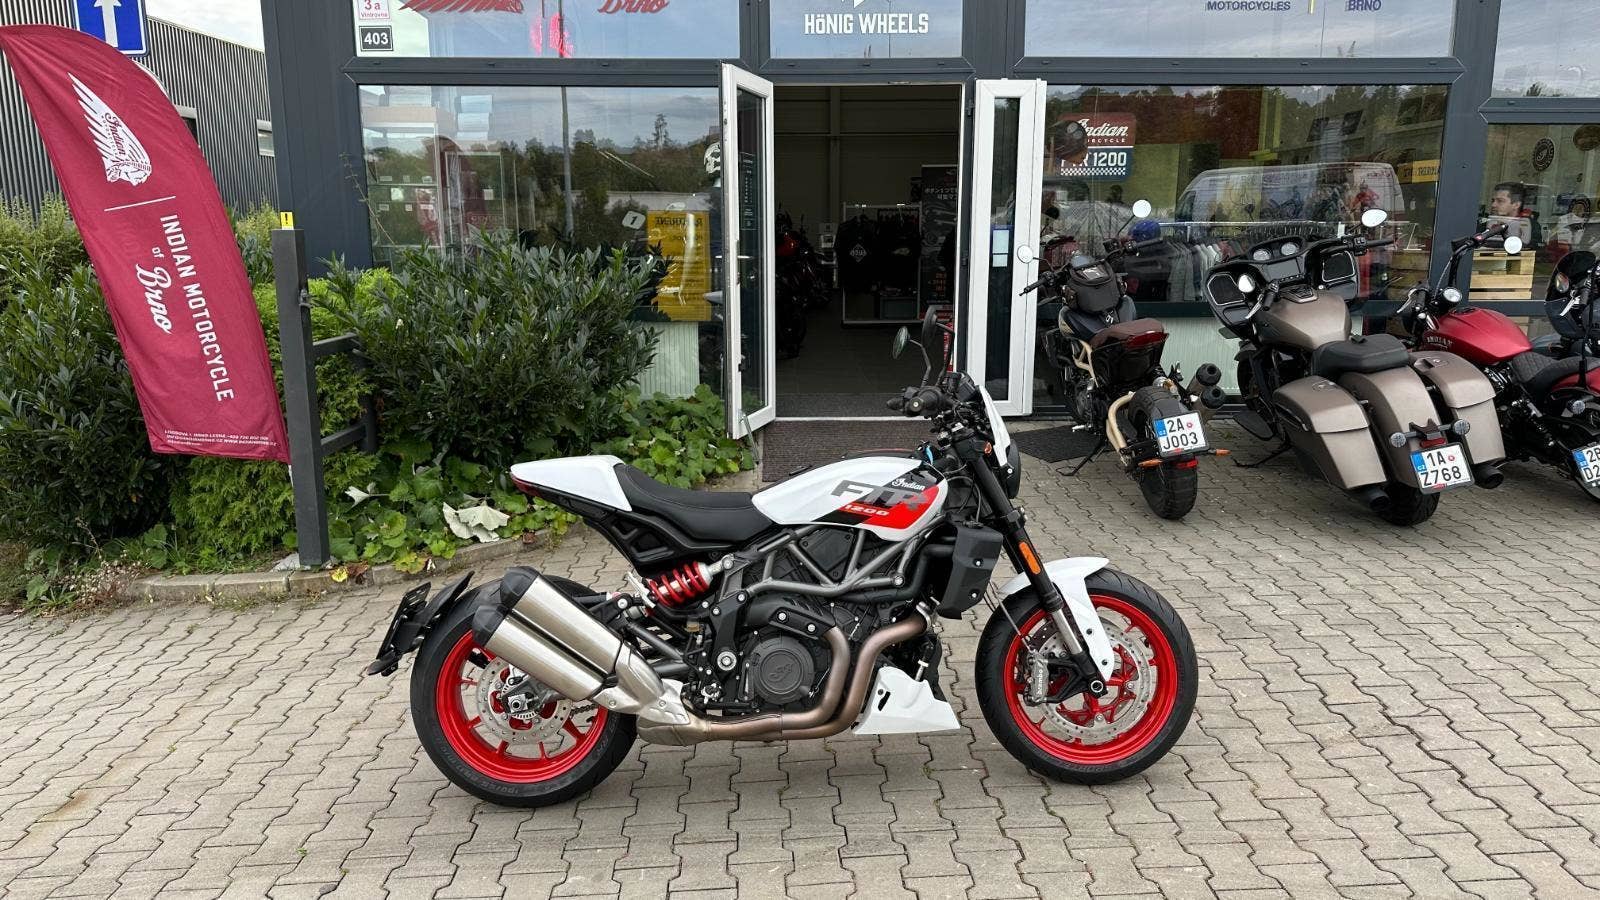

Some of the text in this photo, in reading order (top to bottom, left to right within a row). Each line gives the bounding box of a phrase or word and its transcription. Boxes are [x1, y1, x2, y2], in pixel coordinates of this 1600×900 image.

[1206, 1, 1291, 11] MOTORCYCLES
[1347, 0, 1382, 11] BRNO
[858, 12, 930, 35] WHEELS
[363, 32, 389, 45] 403
[1078, 118, 1129, 137] Indian
[1092, 151, 1127, 167] 1200
[151, 246, 165, 259] of
[135, 263, 174, 335] Brno
[160, 214, 197, 279] INDIAN
[182, 282, 235, 402] MOTORCYCLE
[1166, 418, 1185, 433] 2A
[1163, 431, 1199, 450] J003
[1426, 451, 1447, 466] 1A
[1420, 465, 1462, 486] Z768
[891, 478, 926, 492] Indian
[844, 504, 890, 516] 1200
